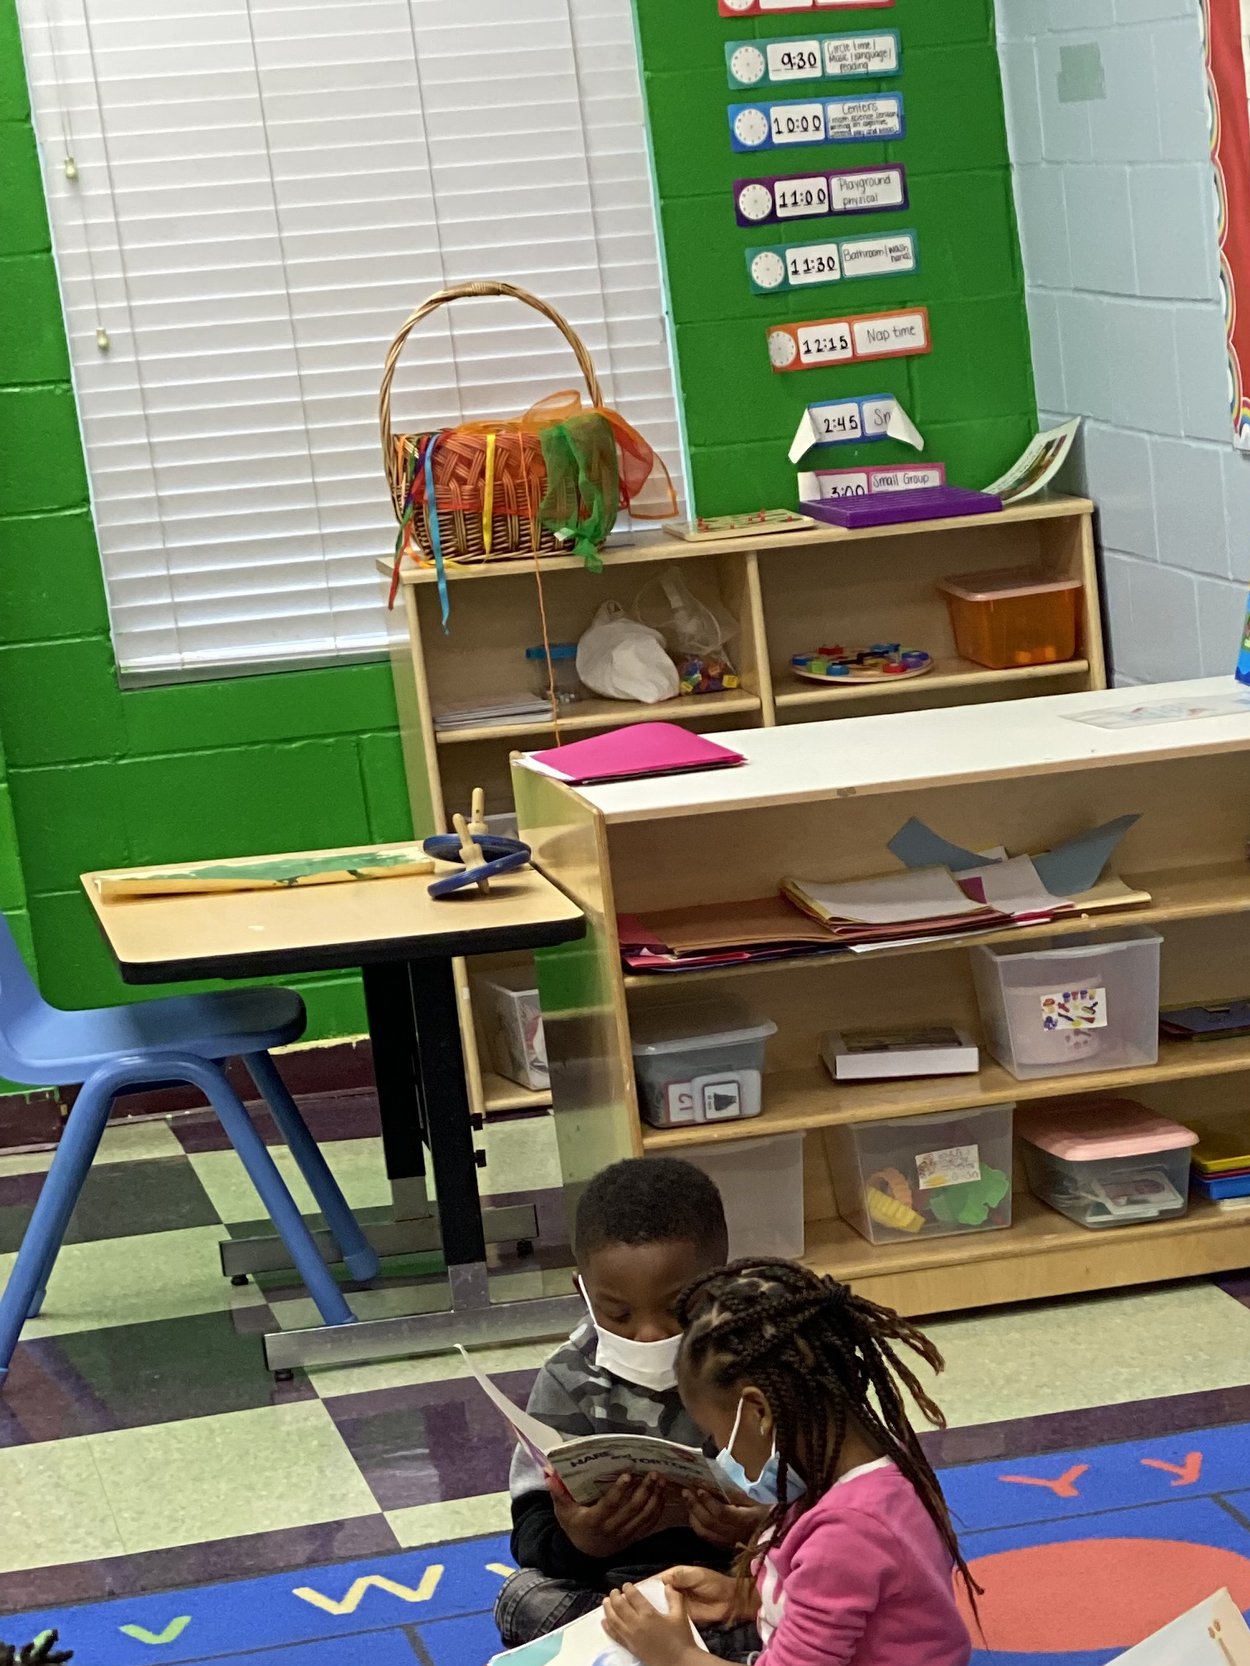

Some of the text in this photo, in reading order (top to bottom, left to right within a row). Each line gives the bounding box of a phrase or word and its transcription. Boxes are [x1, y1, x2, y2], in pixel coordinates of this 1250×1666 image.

[781, 52, 817, 69] 9:30
[773, 115, 822, 135] 10:00
[838, 175, 891, 194] Playground
[778, 188, 827, 208] 11:00
[790, 256, 836, 275] 11:30
[866, 324, 916, 344] Nap time
[802, 334, 849, 355] 12:15
[823, 414, 858, 433] 2:45
[872, 469, 929, 488] Small Group
